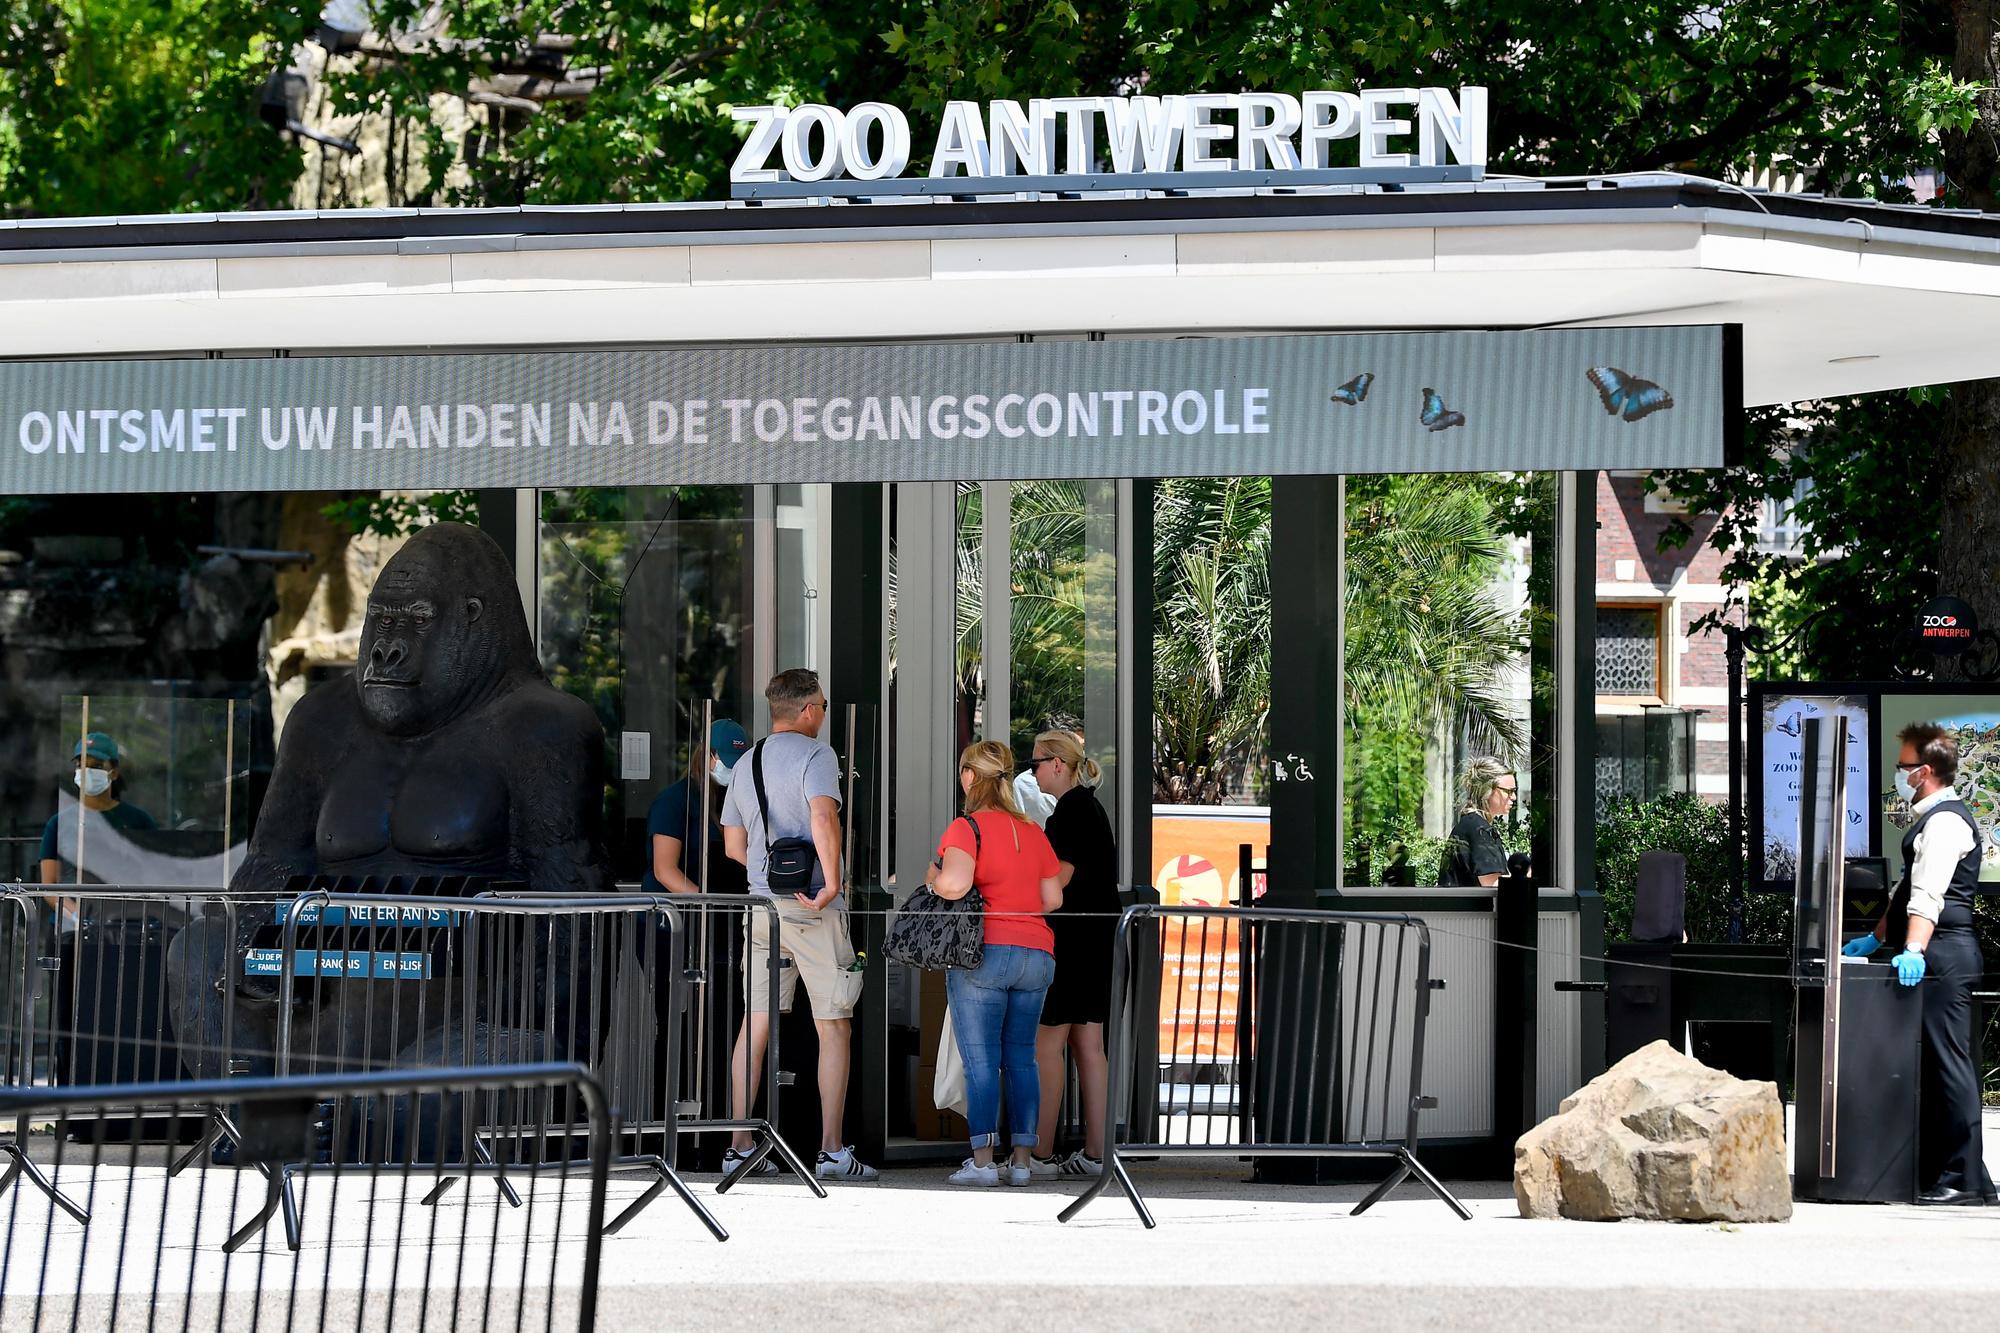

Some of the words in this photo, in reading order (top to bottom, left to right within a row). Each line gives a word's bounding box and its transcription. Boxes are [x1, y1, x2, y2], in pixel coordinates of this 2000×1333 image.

[730, 101, 911, 182] ZOO
[928, 86, 1488, 177] ANTWERPEN
[19, 408, 246, 454] ONTSMET
[261, 406, 338, 451] UW
[352, 402, 551, 450] HANDEN
[568, 400, 634, 446] NA
[647, 399, 709, 445] DE
[722, 387, 1270, 443] TOEGANGSCONTROLE
[1923, 627, 1970, 638] ANTWERPEN
[1773, 763, 1798, 773] ZOO
